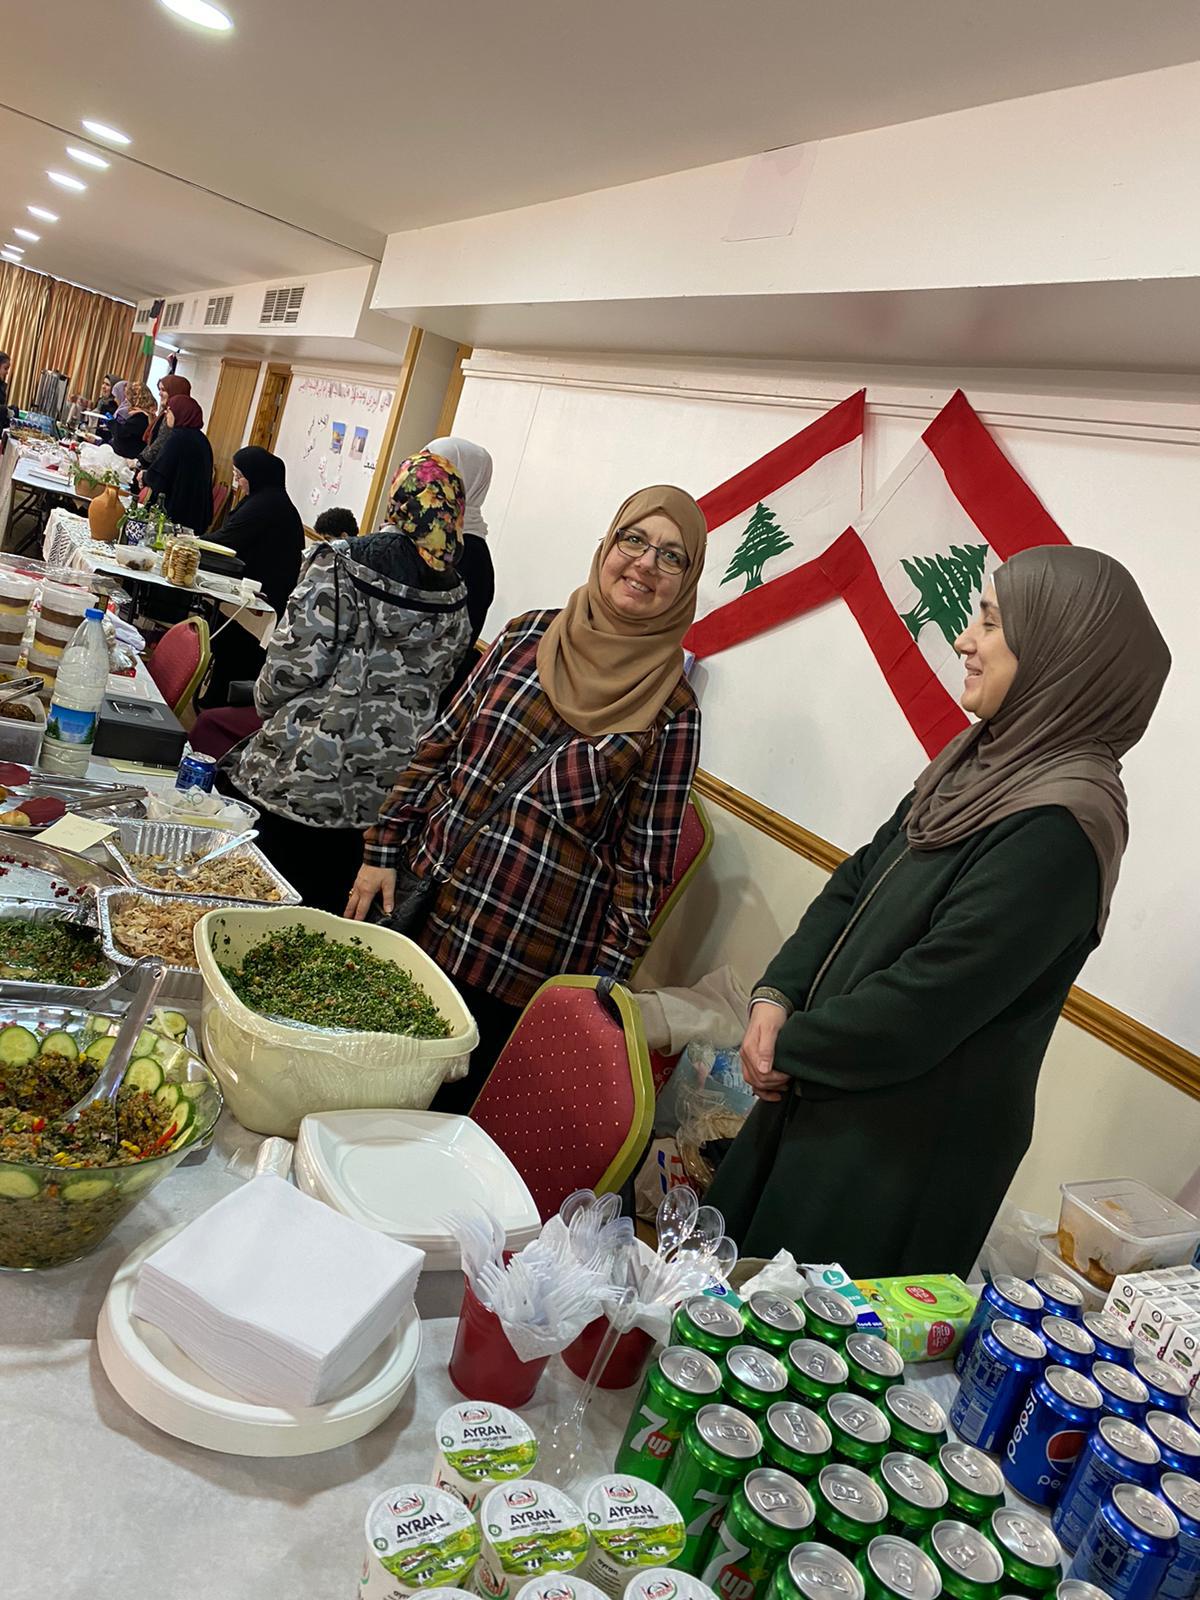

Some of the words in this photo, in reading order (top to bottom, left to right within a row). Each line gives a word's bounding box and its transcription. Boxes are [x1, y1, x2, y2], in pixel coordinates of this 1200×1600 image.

[1007, 1380, 1038, 1465] pepsi
[463, 1425, 507, 1439] AYRAN
[510, 1508, 556, 1526] AYRAN
[609, 1504, 654, 1519] AYRAN
[396, 1512, 444, 1538] AYRAN
